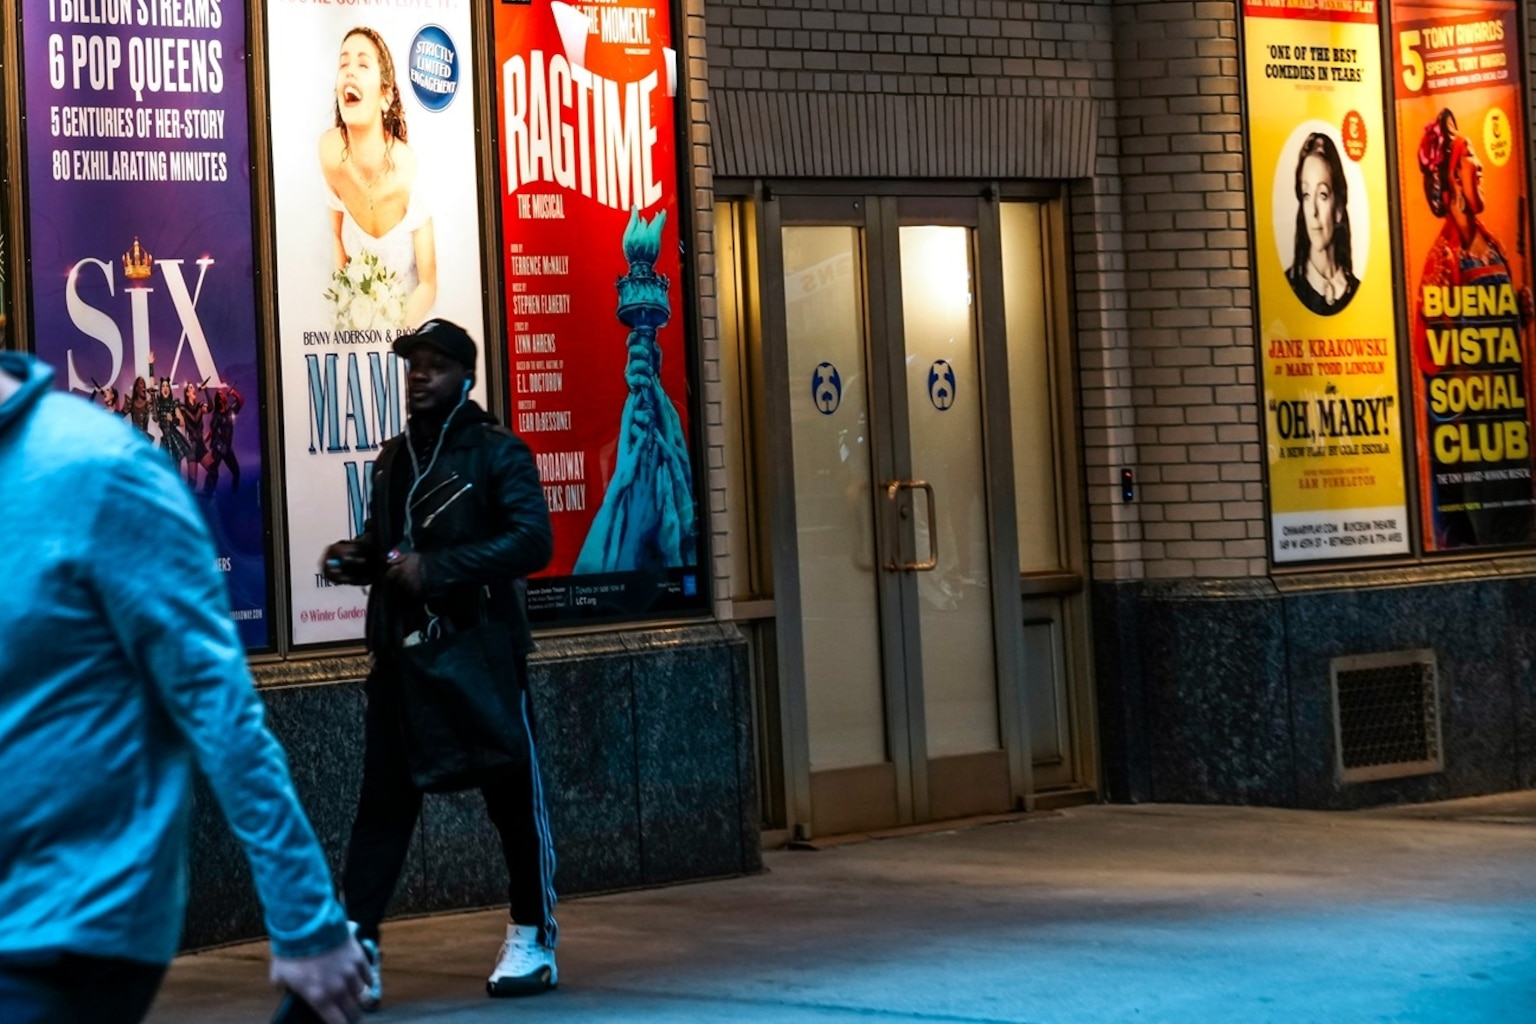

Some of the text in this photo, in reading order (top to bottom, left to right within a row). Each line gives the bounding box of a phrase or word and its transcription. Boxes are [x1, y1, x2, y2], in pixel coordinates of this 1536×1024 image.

[415, 41, 455, 64] STRICTLY
[1294, 46, 1307, 61] OF
[1310, 47, 1330, 62] THE
[1333, 49, 1357, 64] BEST
[1400, 30, 1424, 91] 5
[1422, 26, 1454, 49] TONY
[1456, 19, 1504, 45] AWARDS
[49, 34, 224, 102] 6 POP QUEENS
[417, 56, 452, 78] LIMITED
[1265, 64, 1328, 81] COMEDIES IN
[410, 68, 456, 94] ENGAGEMENT
[51, 106, 224, 140] 5 CENTURIES OF HER-STORY
[503, 50, 663, 211] RAGTIME
[52, 150, 227, 182] 80 EXHILARATING MINUTES
[517, 194, 565, 219] THE MUSICAL
[511, 256, 541, 275] TERRENCE
[513, 294, 570, 315] STEPHEN FLAHERTY
[1422, 283, 1519, 318] BUENA
[65, 257, 228, 392] SIX
[304, 329, 392, 346] BENNY ANDERSSON &
[515, 334, 531, 354] LYNN
[1269, 338, 1388, 358] JANE KRAKOWSKI
[1426, 327, 1522, 366] VISTA
[1286, 361, 1385, 376] MARY TODD LINCOLN
[1430, 375, 1525, 414] SOCIAL
[1434, 421, 1528, 464] CLUB
[536, 451, 584, 482] BROADWAY
[565, 484, 586, 511] ONLY
[309, 606, 367, 623] Winter Garden
